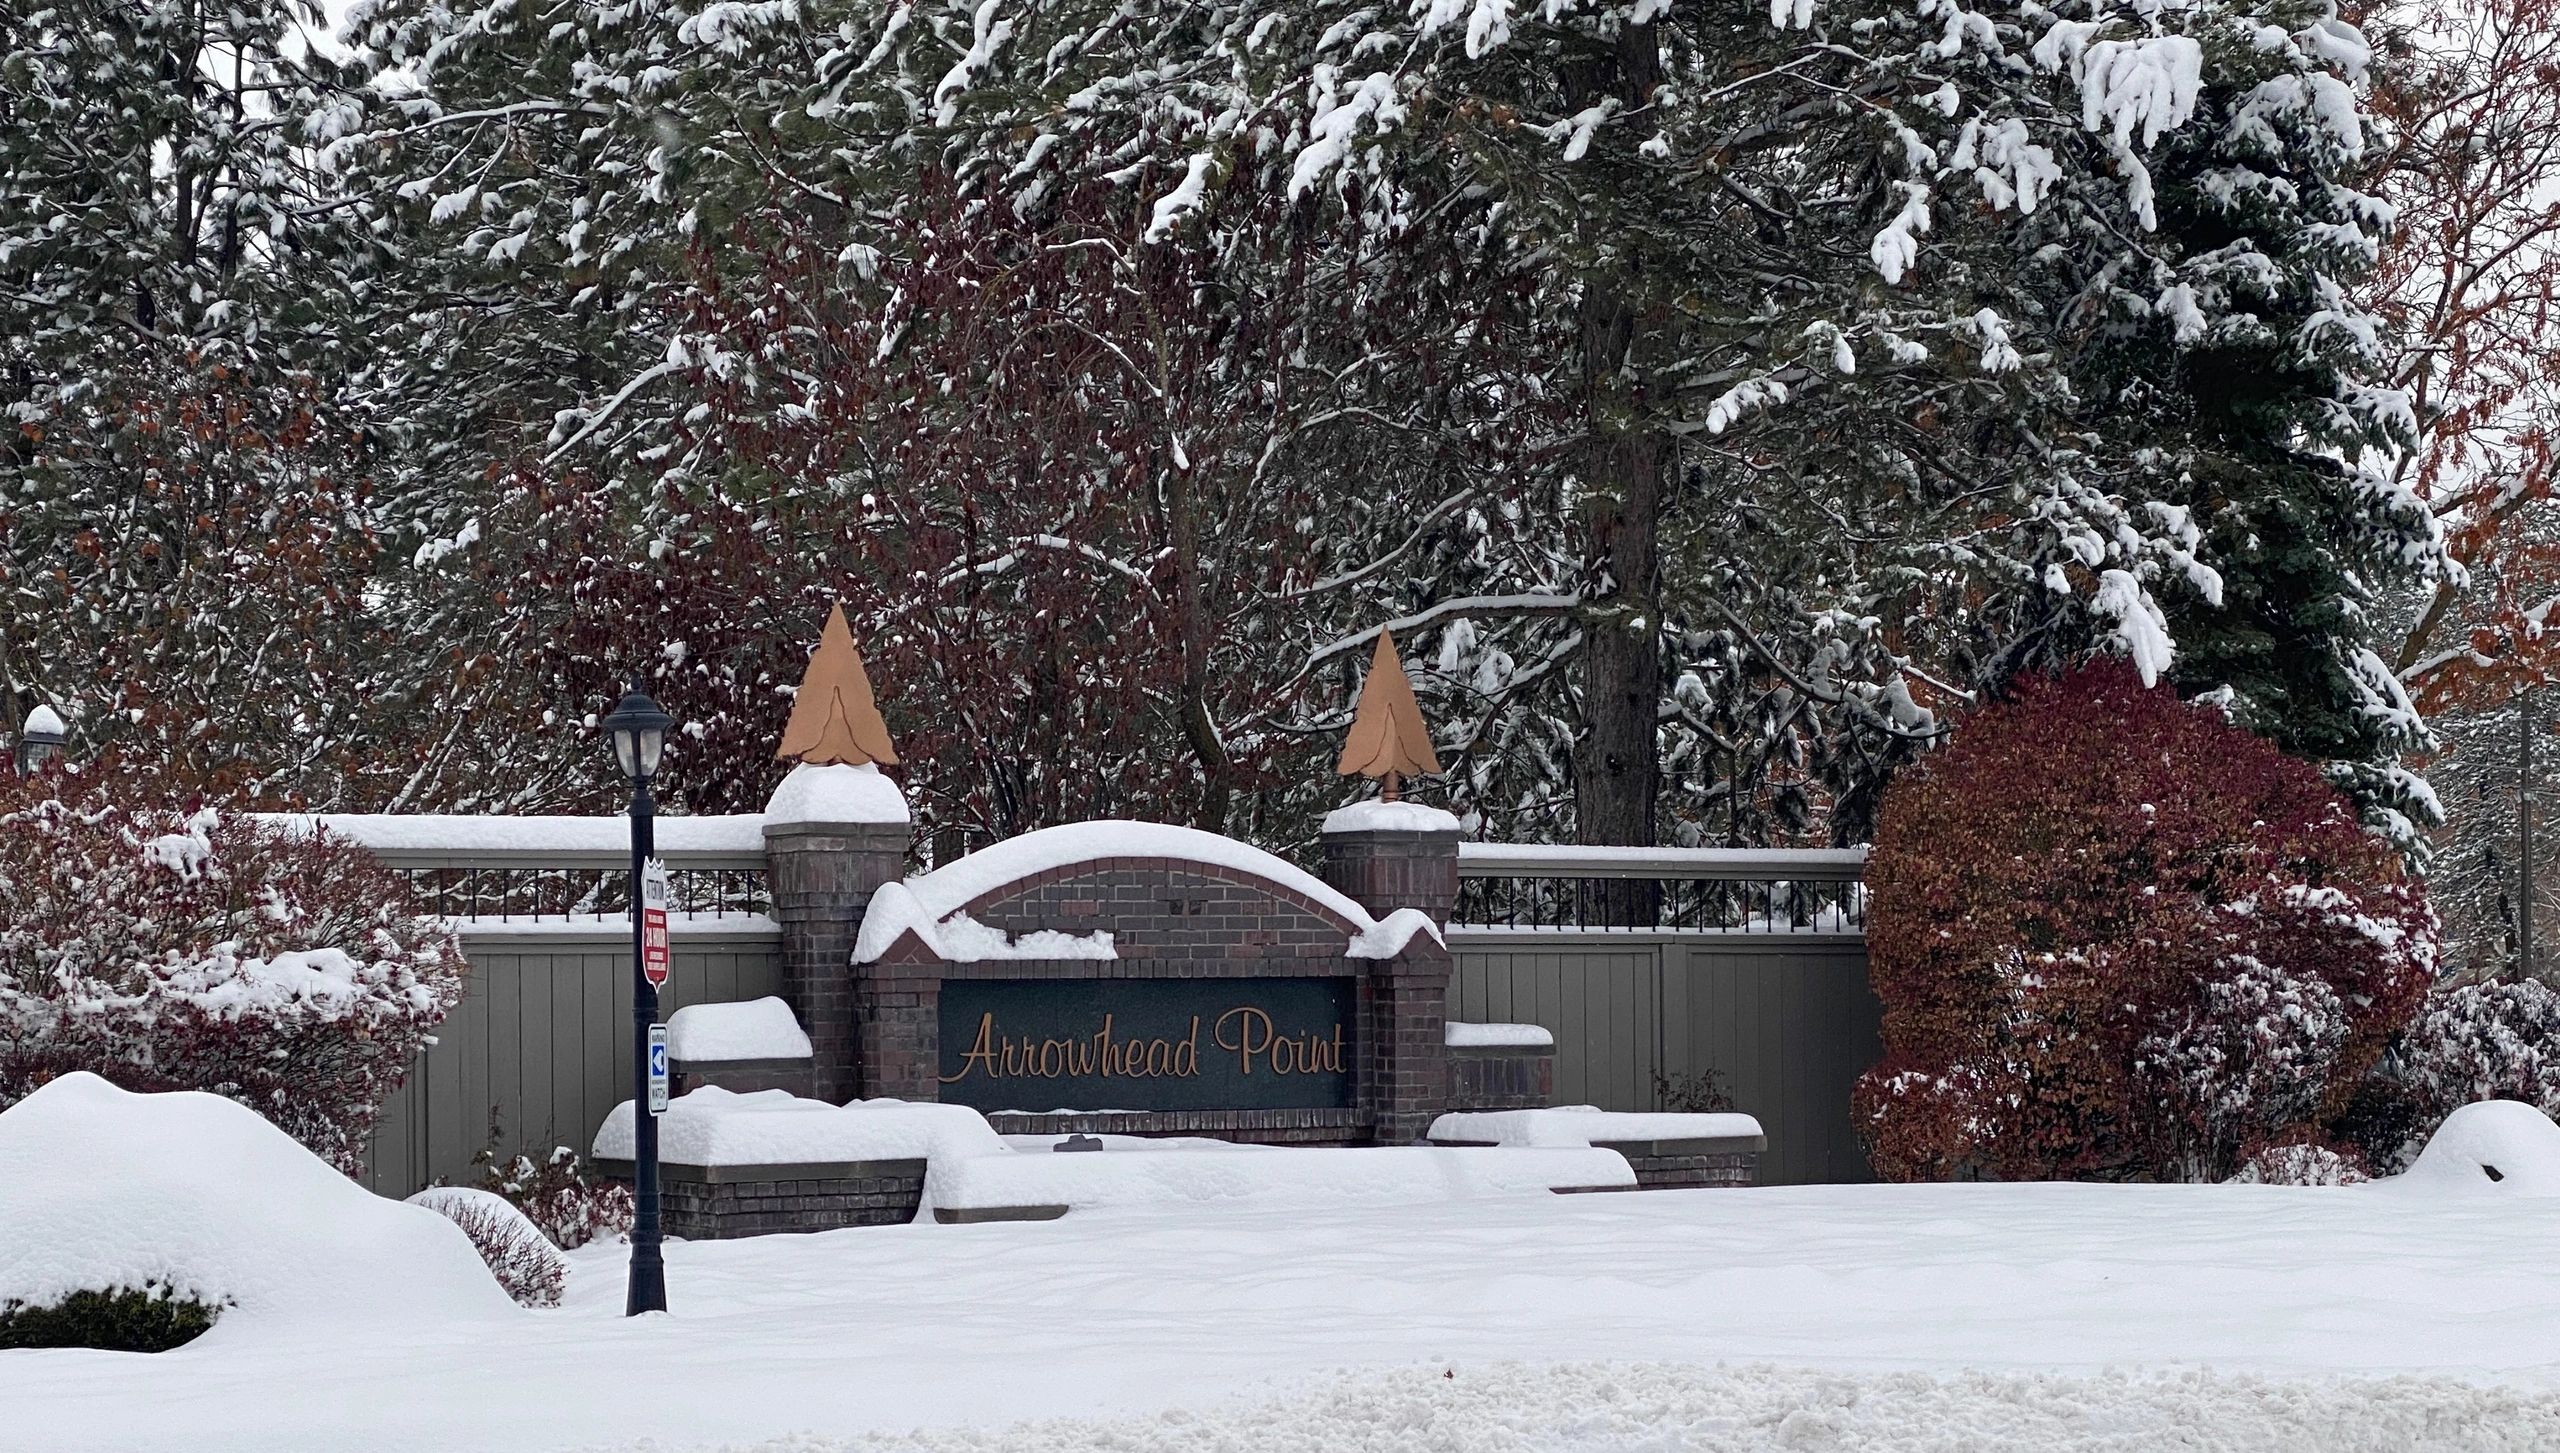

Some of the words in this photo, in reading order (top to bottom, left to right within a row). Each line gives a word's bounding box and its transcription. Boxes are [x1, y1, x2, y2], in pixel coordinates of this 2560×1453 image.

[646, 927, 653, 947] 24
[938, 1012, 1200, 1083] Arrowhead
[1215, 1007, 1347, 1075] Point
